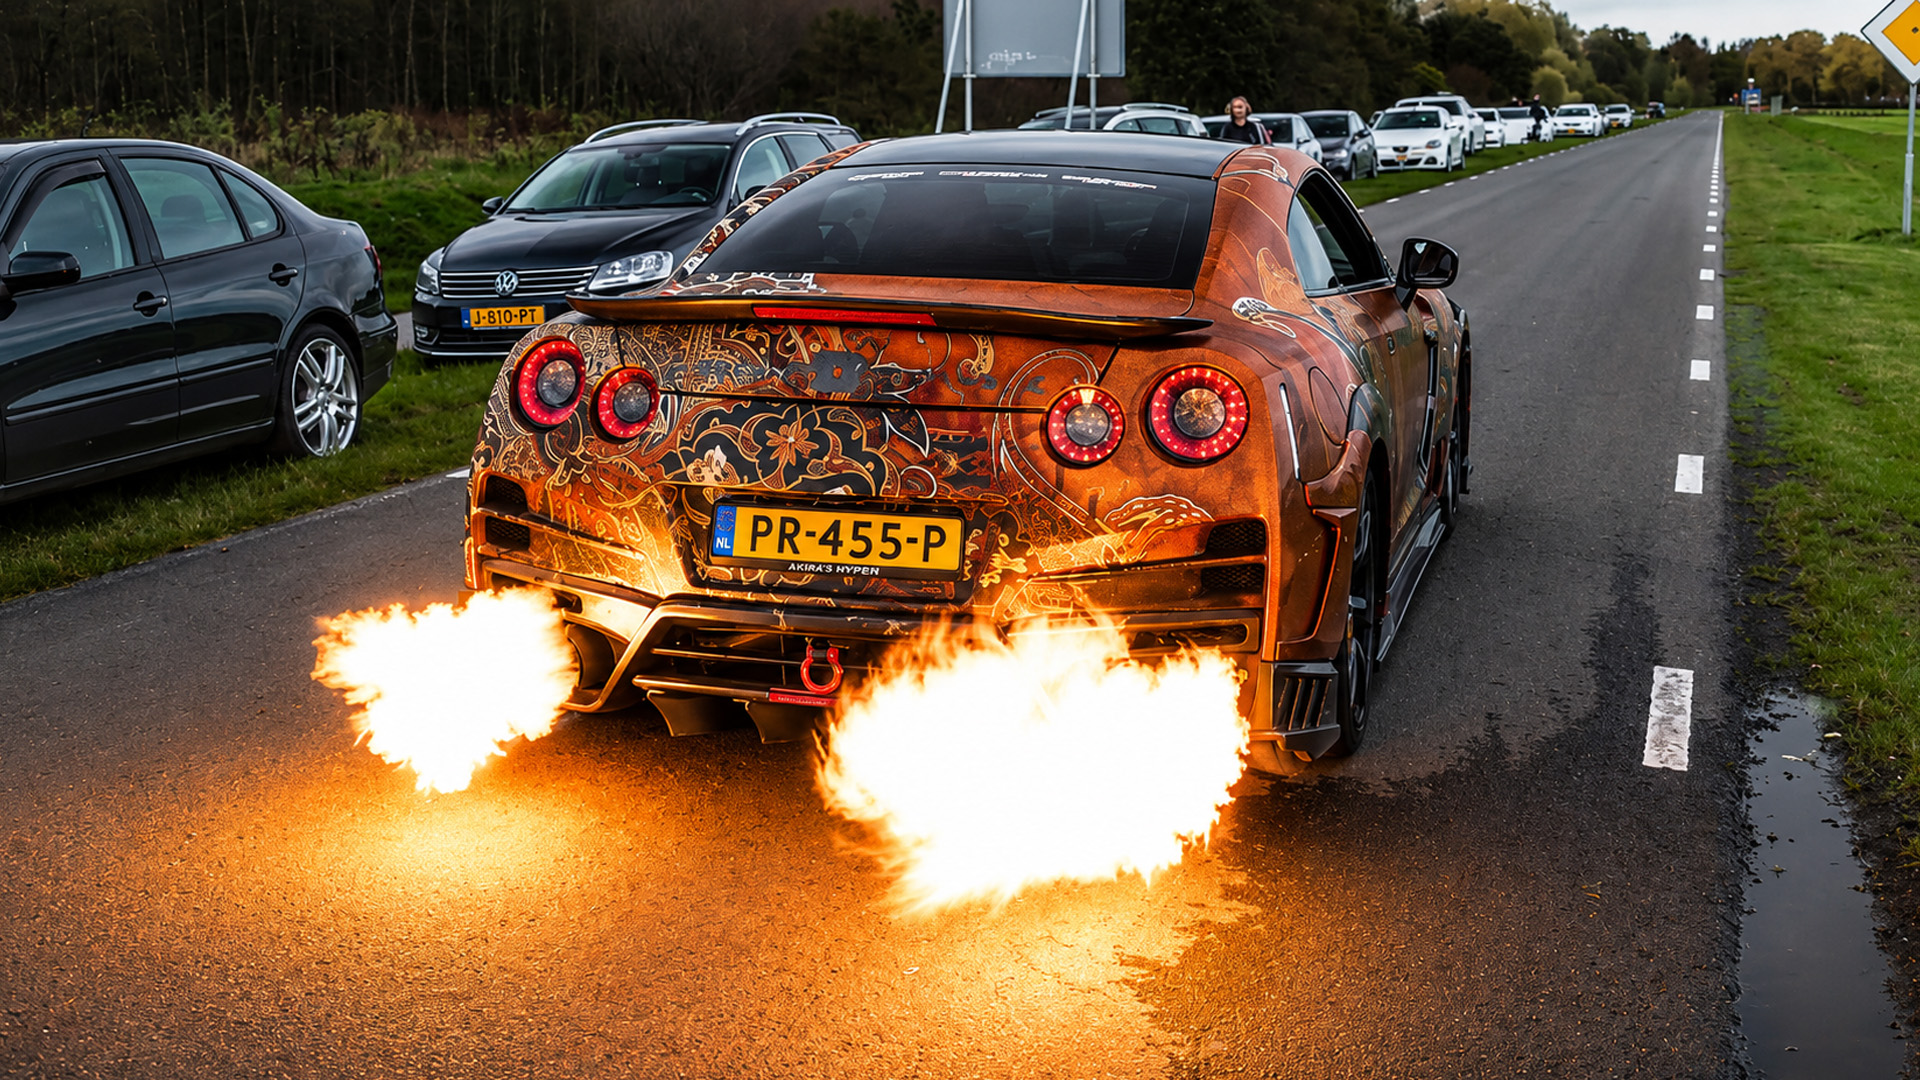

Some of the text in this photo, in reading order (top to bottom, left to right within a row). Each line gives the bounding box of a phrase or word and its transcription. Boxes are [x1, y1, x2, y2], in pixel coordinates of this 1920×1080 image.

[474, 308, 537, 325] J-810-PT
[715, 537, 731, 549] NL
[750, 514, 947, 563] PR-455-P
